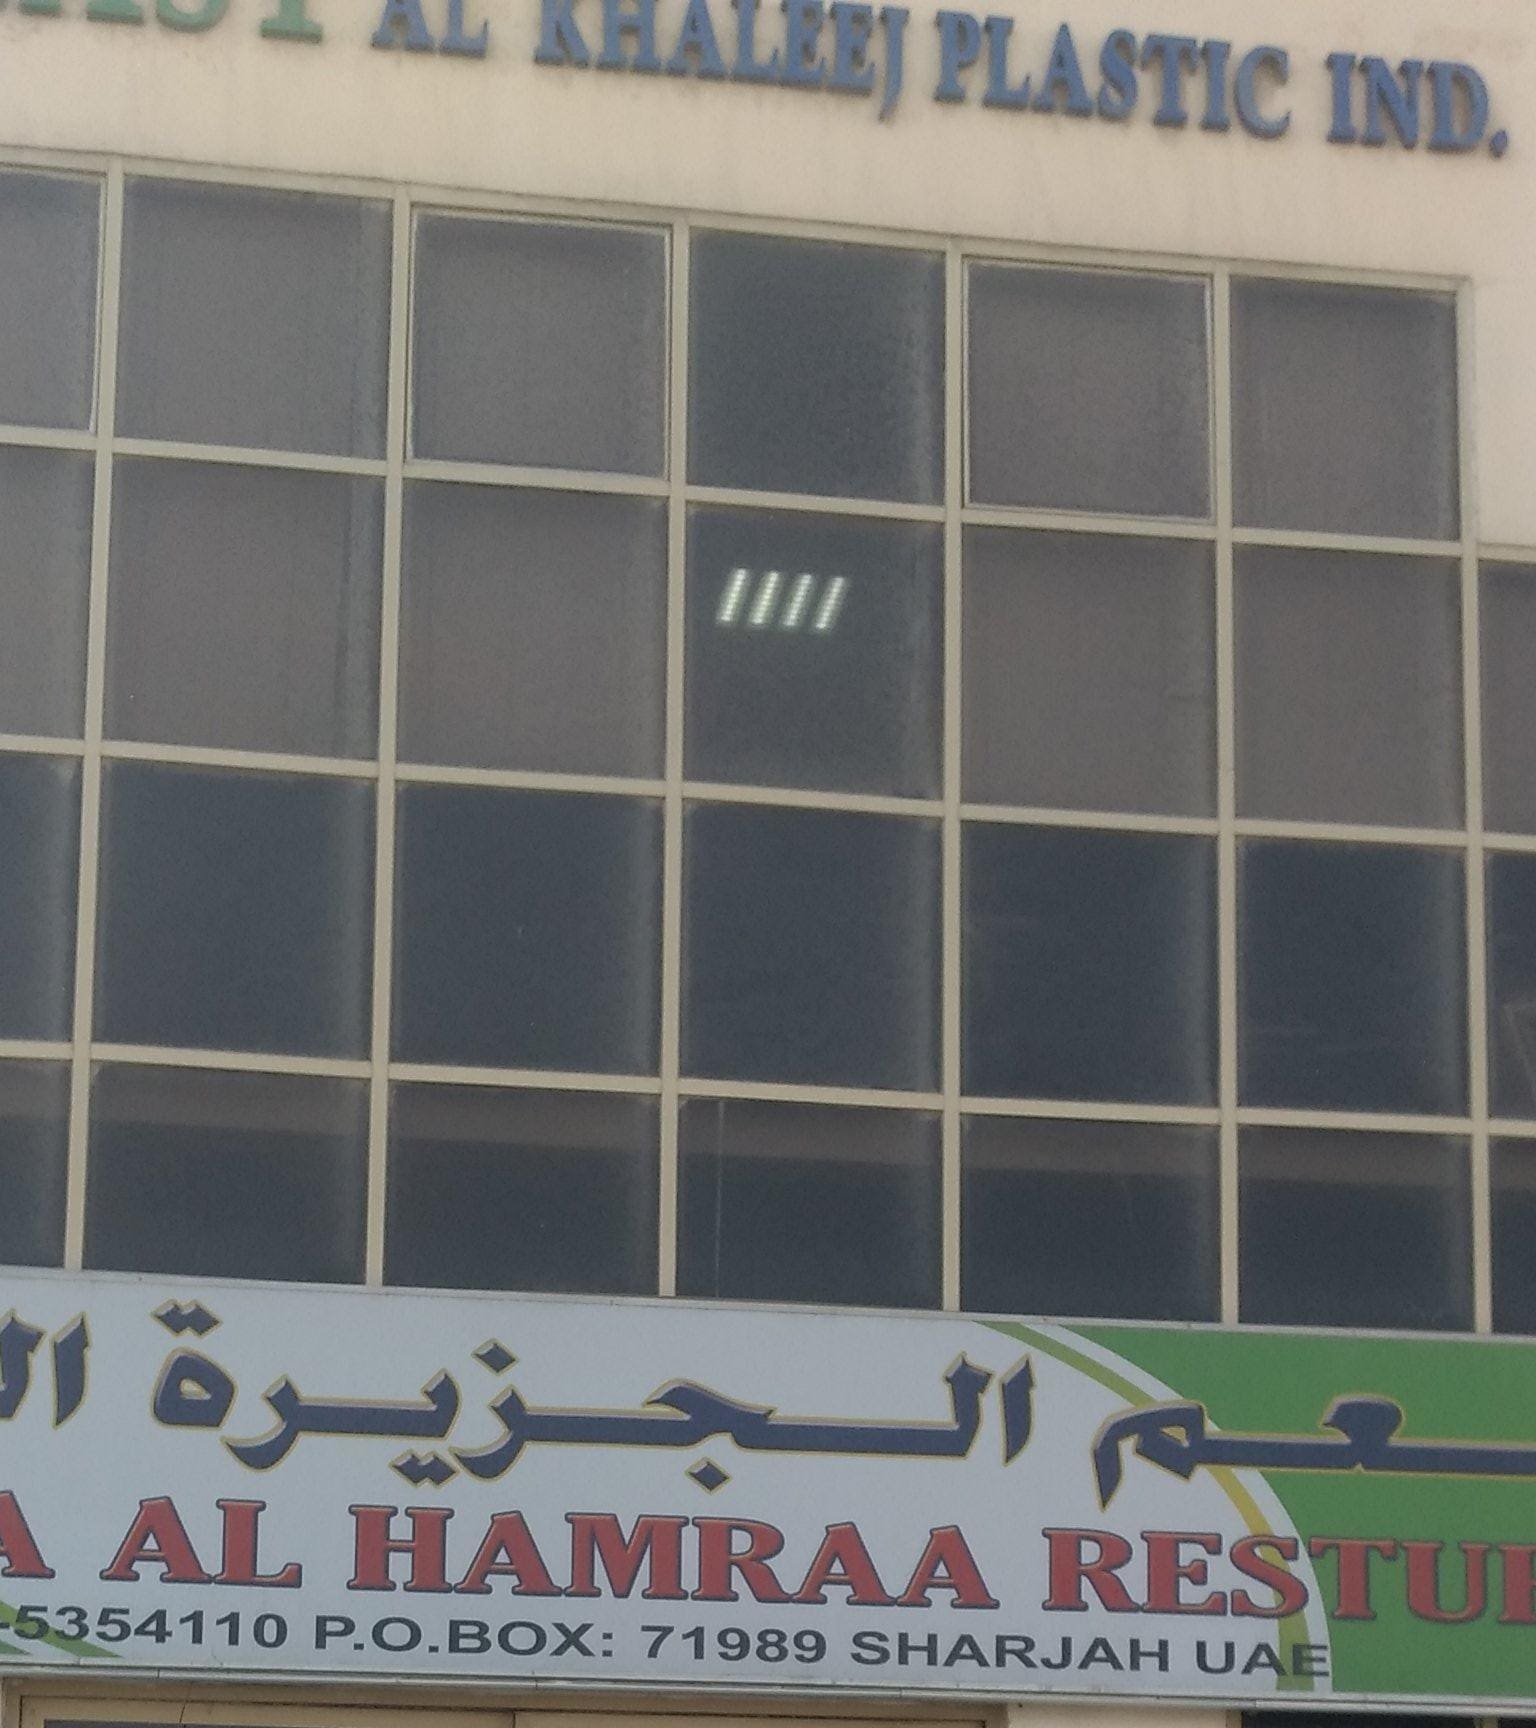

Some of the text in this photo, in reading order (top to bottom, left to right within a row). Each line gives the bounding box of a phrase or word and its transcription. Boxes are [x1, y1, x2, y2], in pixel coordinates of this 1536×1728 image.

[534, 0, 910, 120] KHALEEJ
[935, 9, 1292, 140] PLASTIC
[1324, 51, 1511, 159] IND.
[150, 1300, 1037, 1496] الجزيرة
[103, 1496, 305, 1591] AL
[346, 1503, 1001, 1612] HAMRAA
[314, 1614, 614, 1658] P.O.BOX:
[639, 1625, 828, 1664] 71989
[850, 1630, 1170, 1673] SHARJAH
[1195, 1639, 1331, 1678] UAE
